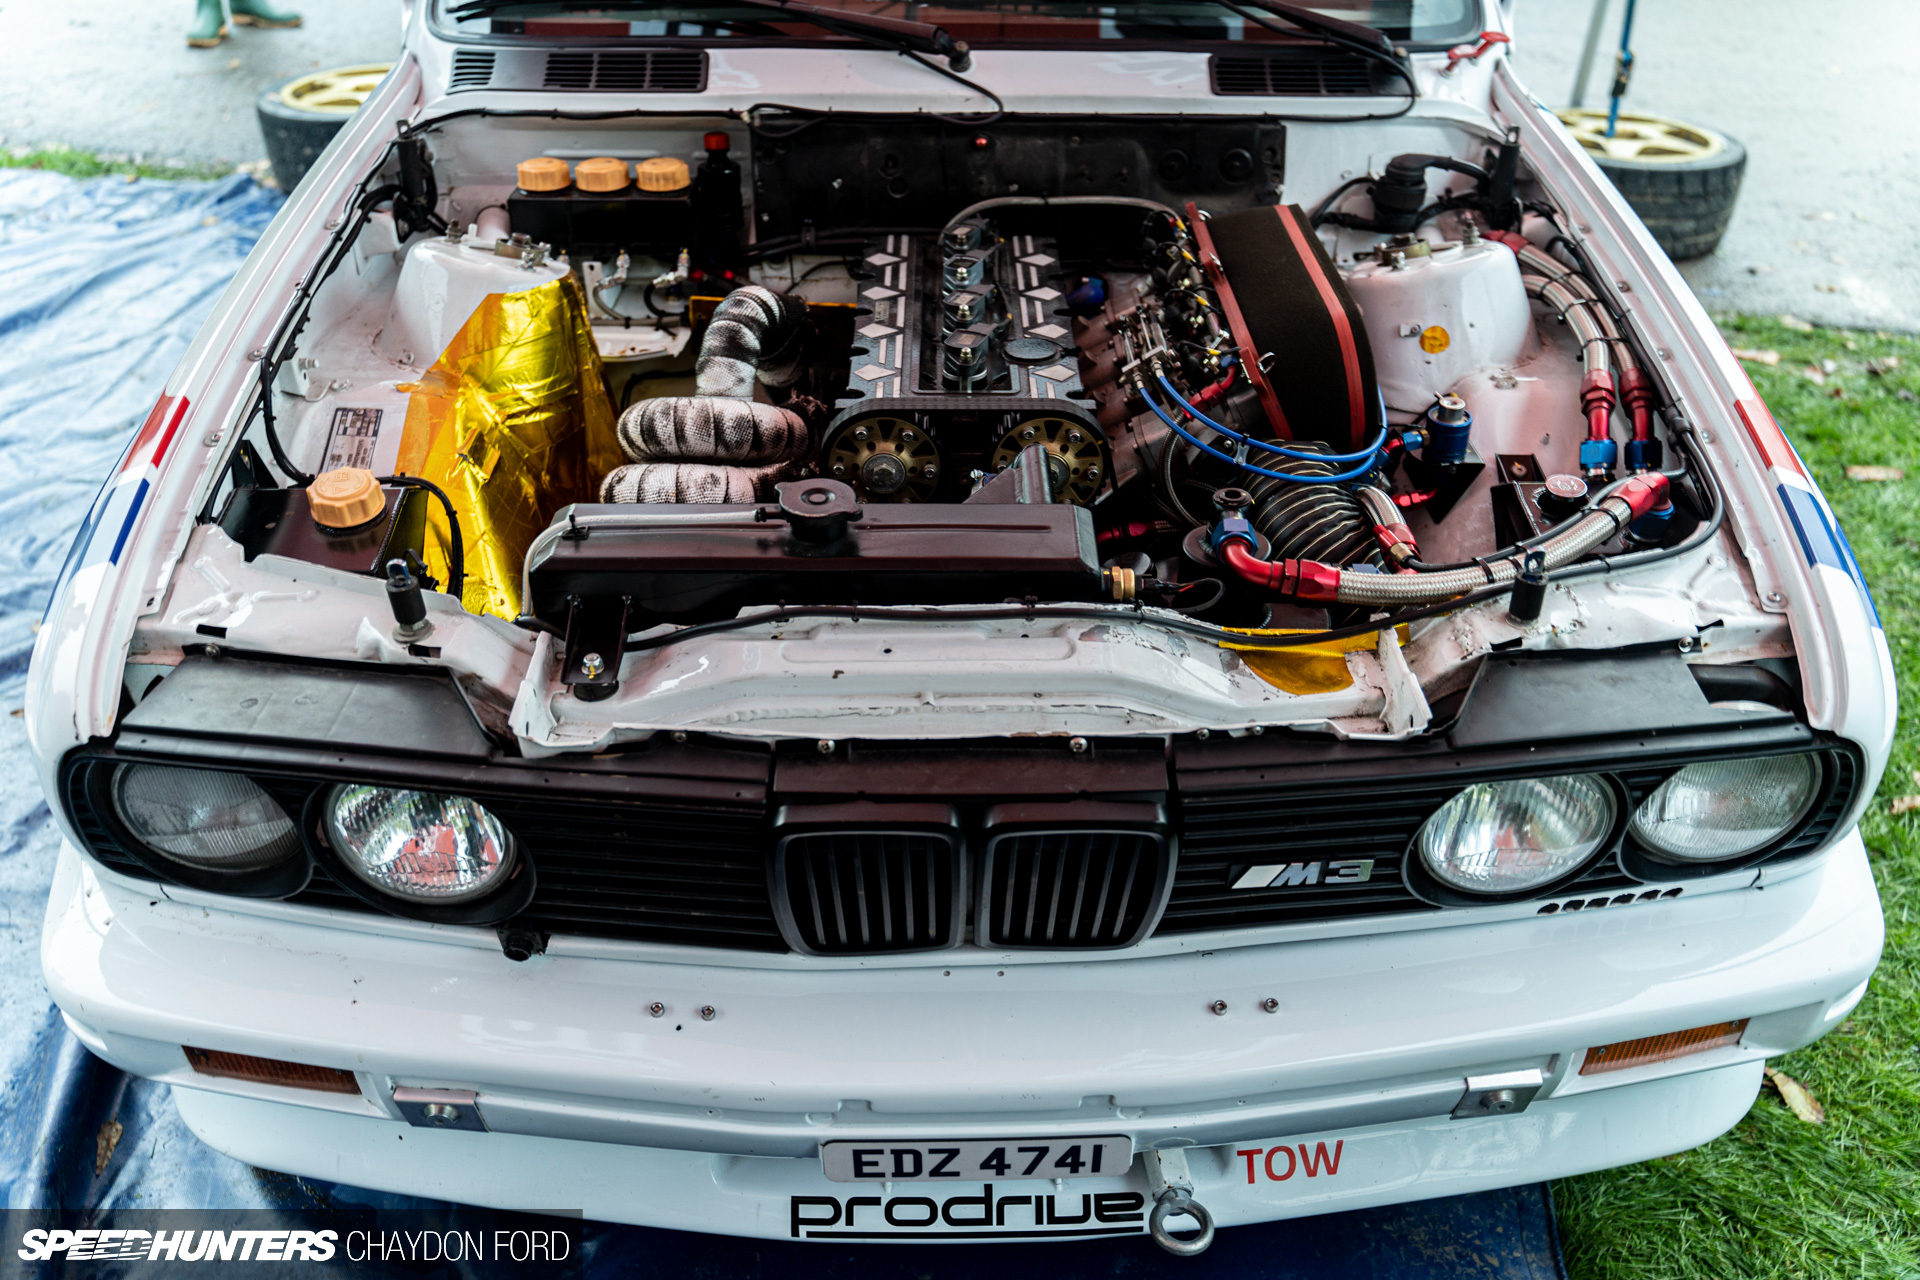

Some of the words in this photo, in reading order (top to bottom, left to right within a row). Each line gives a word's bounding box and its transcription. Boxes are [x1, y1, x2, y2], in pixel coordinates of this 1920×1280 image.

[851, 1147, 961, 1179] EDZ
[979, 1144, 1104, 1177] 4741
[1236, 1140, 1344, 1185] TOW
[790, 1183, 1145, 1238] prodrive
